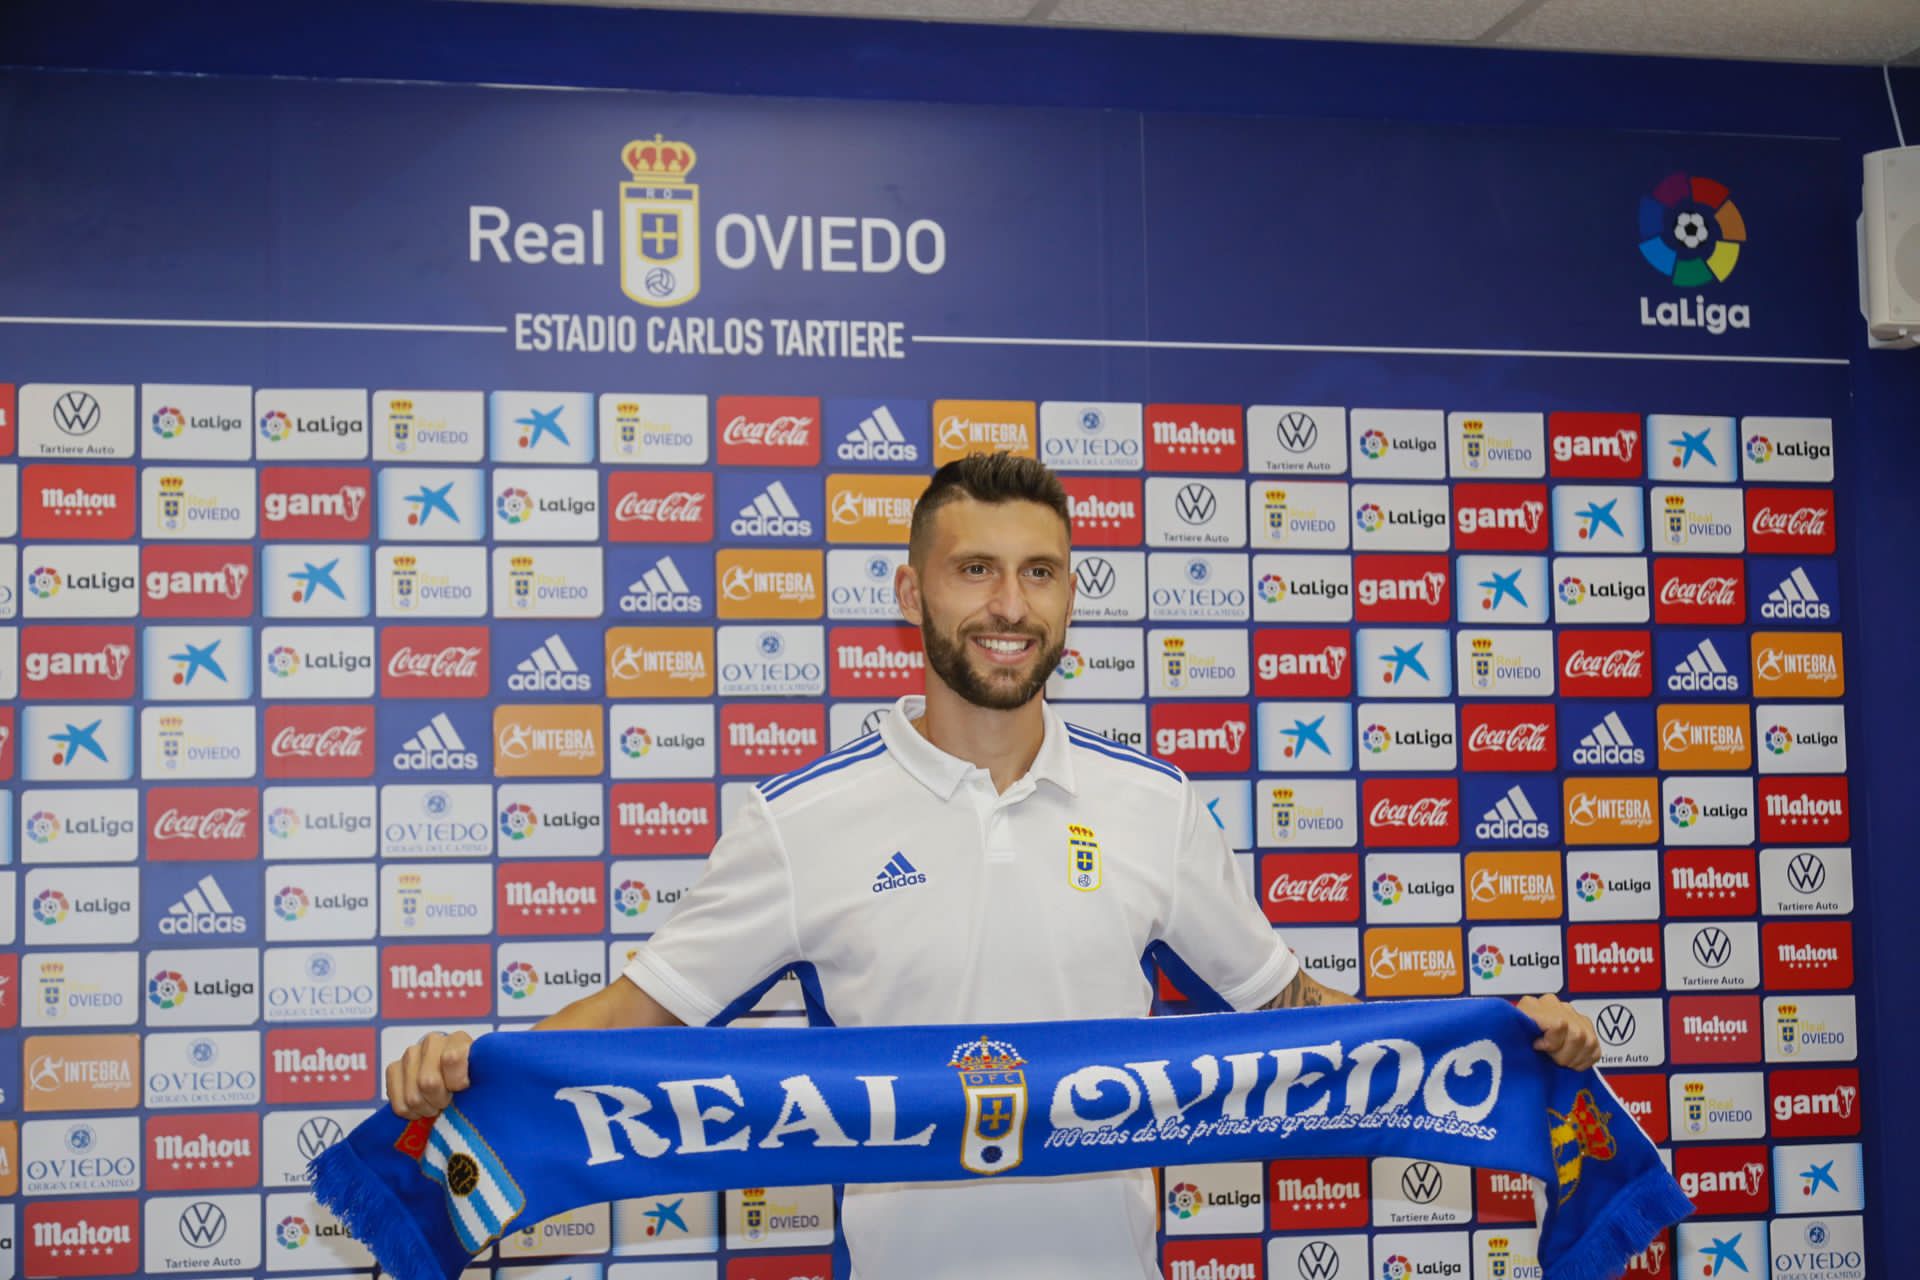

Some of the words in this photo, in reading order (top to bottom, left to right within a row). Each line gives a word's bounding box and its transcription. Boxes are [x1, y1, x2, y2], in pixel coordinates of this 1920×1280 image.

[469, 206, 604, 265] Real
[716, 214, 945, 274] OVIEDO
[1640, 296, 1750, 334] LaLiga
[515, 314, 637, 352] ESTADIO
[647, 317, 763, 355] CARLOS
[771, 320, 905, 358] TARTIERE
[191, 416, 242, 432] LaLiga
[297, 416, 362, 435] LaLiga
[969, 421, 1028, 443] INTEGRA
[418, 431, 468, 443] OVIEDO
[643, 433, 692, 446] OVIEDO
[1153, 422, 1235, 446] Mahou
[39, 444, 81, 454] Tartiere
[87, 444, 114, 454] Auto
[838, 440, 917, 461] adidas
[1046, 438, 1138, 455] OVIEDO
[1393, 438, 1436, 452] LaLiga
[1777, 442, 1830, 459] LaLiga
[1488, 448, 1531, 461] OVIEDO
[1267, 462, 1306, 471] Tartiere
[1311, 462, 1331, 471] Auto
[42, 488, 116, 509] Mahou
[539, 498, 595, 514] LaLiga
[188, 507, 240, 520] OVIEDO
[1389, 510, 1445, 528] LaLiga
[731, 517, 812, 536] adidas
[1290, 520, 1335, 532] OVIEDO
[1689, 523, 1731, 536] OVIEDO
[1164, 533, 1202, 542] Tartiere
[1205, 534, 1229, 543] Auto
[67, 572, 134, 593] LaLiga
[754, 572, 814, 593] INTEGRA
[1291, 581, 1348, 598] LaLiga
[1590, 583, 1645, 599] LaLiga
[421, 585, 471, 599] OVIEDO
[537, 586, 587, 599] OVIEDO
[1153, 589, 1244, 606] OVIEDO
[620, 592, 701, 612] adidas
[1761, 600, 1830, 618] adidas
[306, 653, 371, 671] LaLiga
[643, 651, 704, 672] INTEGRA
[838, 646, 924, 668] Mahou
[1089, 656, 1135, 672] LaLiga
[1784, 656, 1836, 673] INTEGRA
[508, 671, 591, 691] adidas
[723, 664, 819, 682] OVIEDO
[1189, 666, 1235, 679] OVIEDO
[1497, 666, 1540, 679] OVIEDO
[1668, 670, 1738, 691] adidas
[532, 728, 594, 749] INTEGRA
[656, 734, 704, 749] LaLiga
[729, 723, 817, 747] Mahou
[1396, 730, 1452, 747] LaLiga
[1690, 725, 1743, 745] INTEGRA
[1797, 733, 1838, 747] LaLiga
[188, 746, 240, 759] OVIEDO
[394, 749, 478, 770] adidas
[1573, 745, 1645, 765] adidas
[619, 803, 708, 825] Mahou
[1597, 799, 1650, 819] INTEGRA
[1703, 805, 1747, 820] LaLiga
[1766, 794, 1842, 816] Mahou
[66, 817, 133, 837] LaLiga
[306, 814, 371, 833] LaLiga
[544, 812, 600, 830] LaLiga
[1298, 818, 1343, 830] OVIEDO
[1476, 819, 1549, 840] adidas
[386, 824, 488, 843] OVIEDO
[872, 872, 926, 893] adidas
[1500, 874, 1553, 895] INTEGRA
[1608, 879, 1651, 893] LaLiga
[1672, 867, 1750, 889] Mahou
[506, 881, 597, 905] Mahou
[1408, 882, 1454, 896] LaLiga
[75, 899, 130, 914] LaLiga
[315, 894, 368, 910] LaLiga
[426, 904, 477, 917] OVIEDO
[1778, 902, 1815, 911] Tartiere
[1818, 902, 1838, 911] Auto
[159, 913, 246, 934] adidas
[1400, 950, 1454, 970] INTEGRA
[1510, 952, 1560, 969] LaLiga
[1574, 941, 1654, 964] Mahou
[1778, 944, 1838, 961] Mahou
[1305, 956, 1356, 972] LaLiga
[390, 964, 483, 988] Mahou
[545, 970, 601, 987] LaLiga
[1683, 976, 1720, 986] Tartiere
[1724, 976, 1744, 985] Auto
[194, 979, 254, 998] LaLiga
[269, 986, 373, 1005] OVIEDO
[69, 993, 122, 1006] OVIEDO
[1683, 1016, 1747, 1034] Mahou
[1801, 1031, 1844, 1044] OVIEDO
[273, 1047, 367, 1073] Mahou
[1627, 1054, 1648, 1062] Auto
[64, 1061, 130, 1082] INTEGRA
[150, 1072, 255, 1092] OVIEDO
[554, 1074, 936, 1166] REAL
[1049, 1038, 1502, 1130] OVIEDO
[1709, 1110, 1752, 1122] OVIEDO
[1044, 1128, 1082, 1149] 100
[1082, 1126, 1129, 1146] años
[1132, 1120, 1157, 1143] de
[1187, 1115, 1281, 1144] primeros
[1281, 1105, 1358, 1139] grandes
[1413, 1111, 1497, 1141] ovetenses
[155, 1134, 250, 1159] Mahou
[27, 1158, 135, 1179] OVIEDO
[1277, 1177, 1360, 1201] Mahou
[1208, 1191, 1261, 1206] LaLiga
[770, 1215, 819, 1229] OVIEDO
[1390, 1213, 1428, 1223] Tartiere
[1432, 1212, 1455, 1222] Auto
[33, 1220, 130, 1246] Mahou
[544, 1222, 594, 1237] OVIEDO
[165, 1258, 209, 1269] Tartiere
[212, 1257, 241, 1267] Auto
[1171, 1258, 1256, 1280] Mahou
[1416, 1261, 1461, 1276] LaLiga
[1775, 1251, 1861, 1271] OVIEDO
